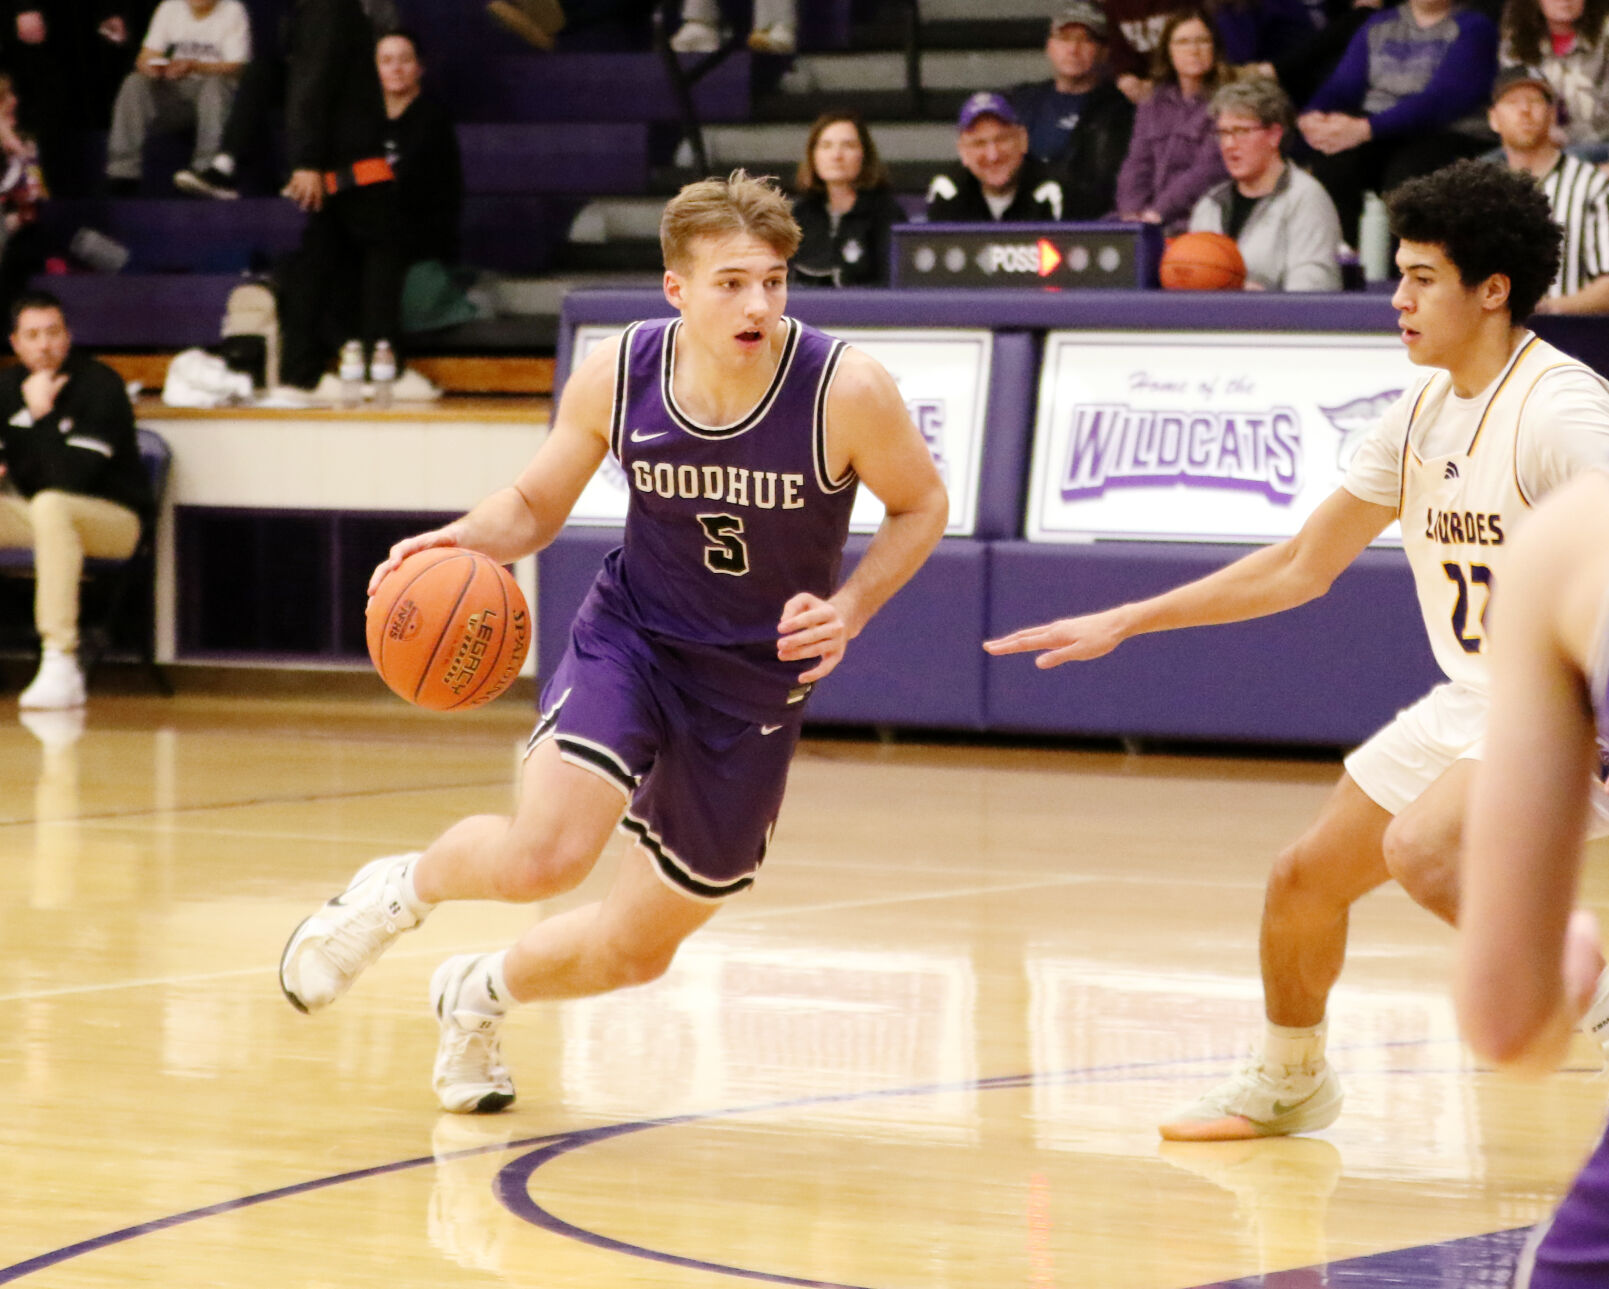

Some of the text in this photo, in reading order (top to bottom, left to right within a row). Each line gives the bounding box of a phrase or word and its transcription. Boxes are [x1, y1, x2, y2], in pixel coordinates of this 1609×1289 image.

[991, 244, 1039, 273] POSS
[1129, 370, 1256, 402] Home of the
[1062, 404, 1304, 500] WILDCATS
[631, 461, 805, 510] GOODHUE
[696, 513, 750, 577] 5
[451, 609, 497, 695] LEGACY
